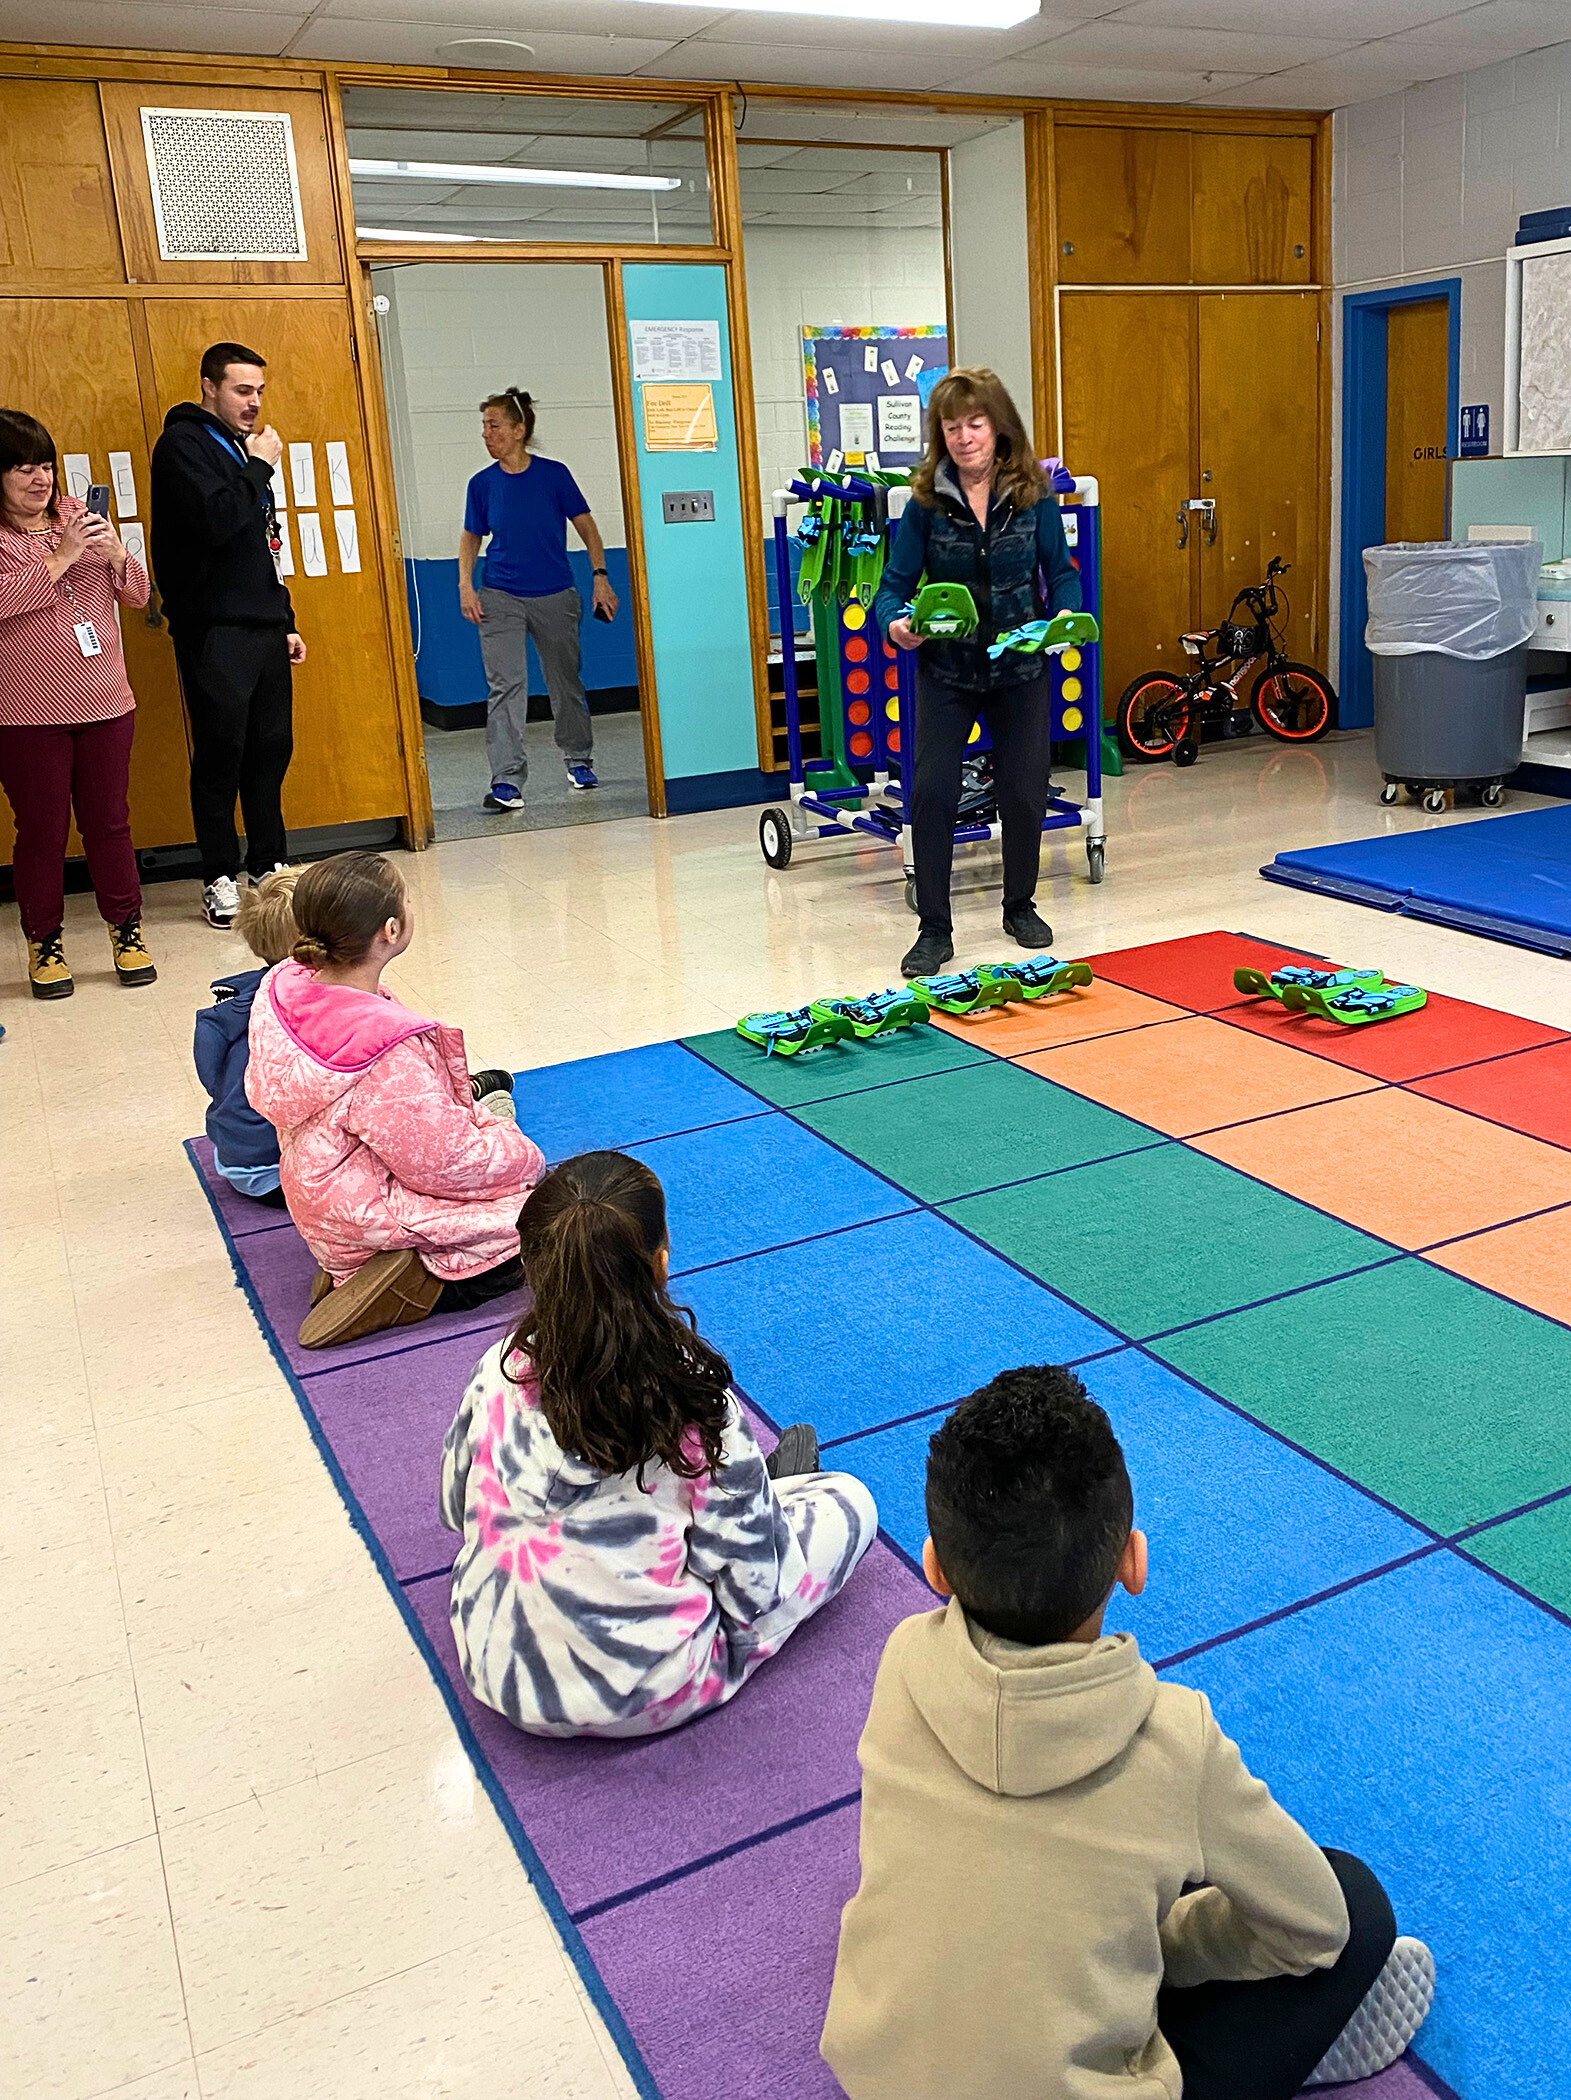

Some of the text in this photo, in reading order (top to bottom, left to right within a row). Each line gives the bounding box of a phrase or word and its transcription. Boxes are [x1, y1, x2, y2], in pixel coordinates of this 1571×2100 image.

[886, 400, 912, 408] Sullivan
[888, 412, 911, 421] County
[885, 423, 911, 432] Reading
[884, 434, 915, 443] Challenge
[1413, 446, 1447, 460] GIRLS
[117, 468, 133, 496] E
[296, 457, 311, 494] J
[331, 458, 349, 493] K
[336, 525, 355, 559] V
